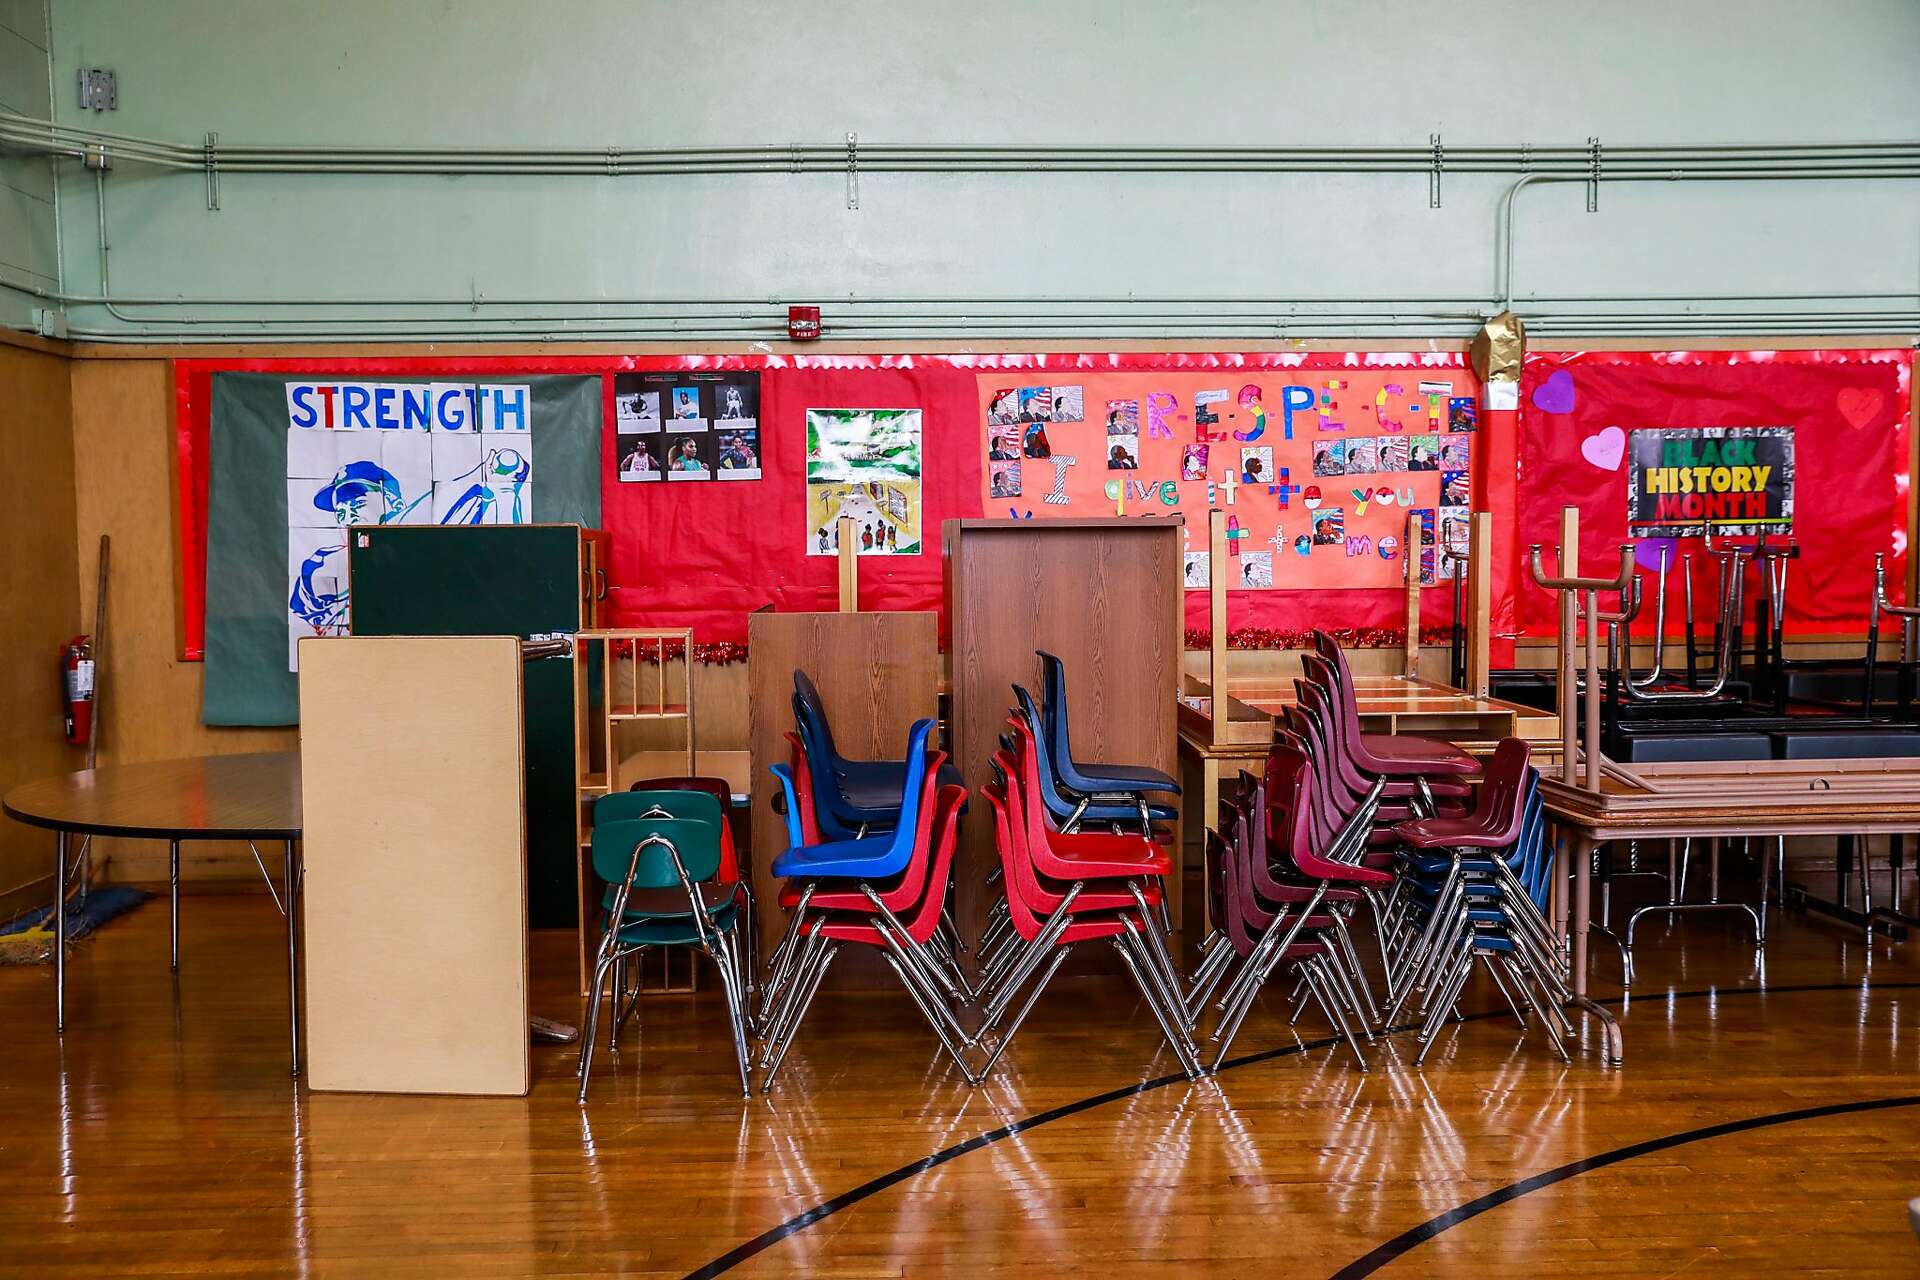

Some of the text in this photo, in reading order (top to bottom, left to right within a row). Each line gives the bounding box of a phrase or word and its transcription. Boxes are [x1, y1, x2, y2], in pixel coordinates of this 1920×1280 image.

[291, 386, 525, 429] STRENGTH
[1663, 440, 1758, 467] BLACK
[1043, 454, 1416, 517] I give it to you
[1646, 466, 1772, 494] HISTORY
[1654, 493, 1768, 519] MONTH
[1346, 535, 1398, 560] me
